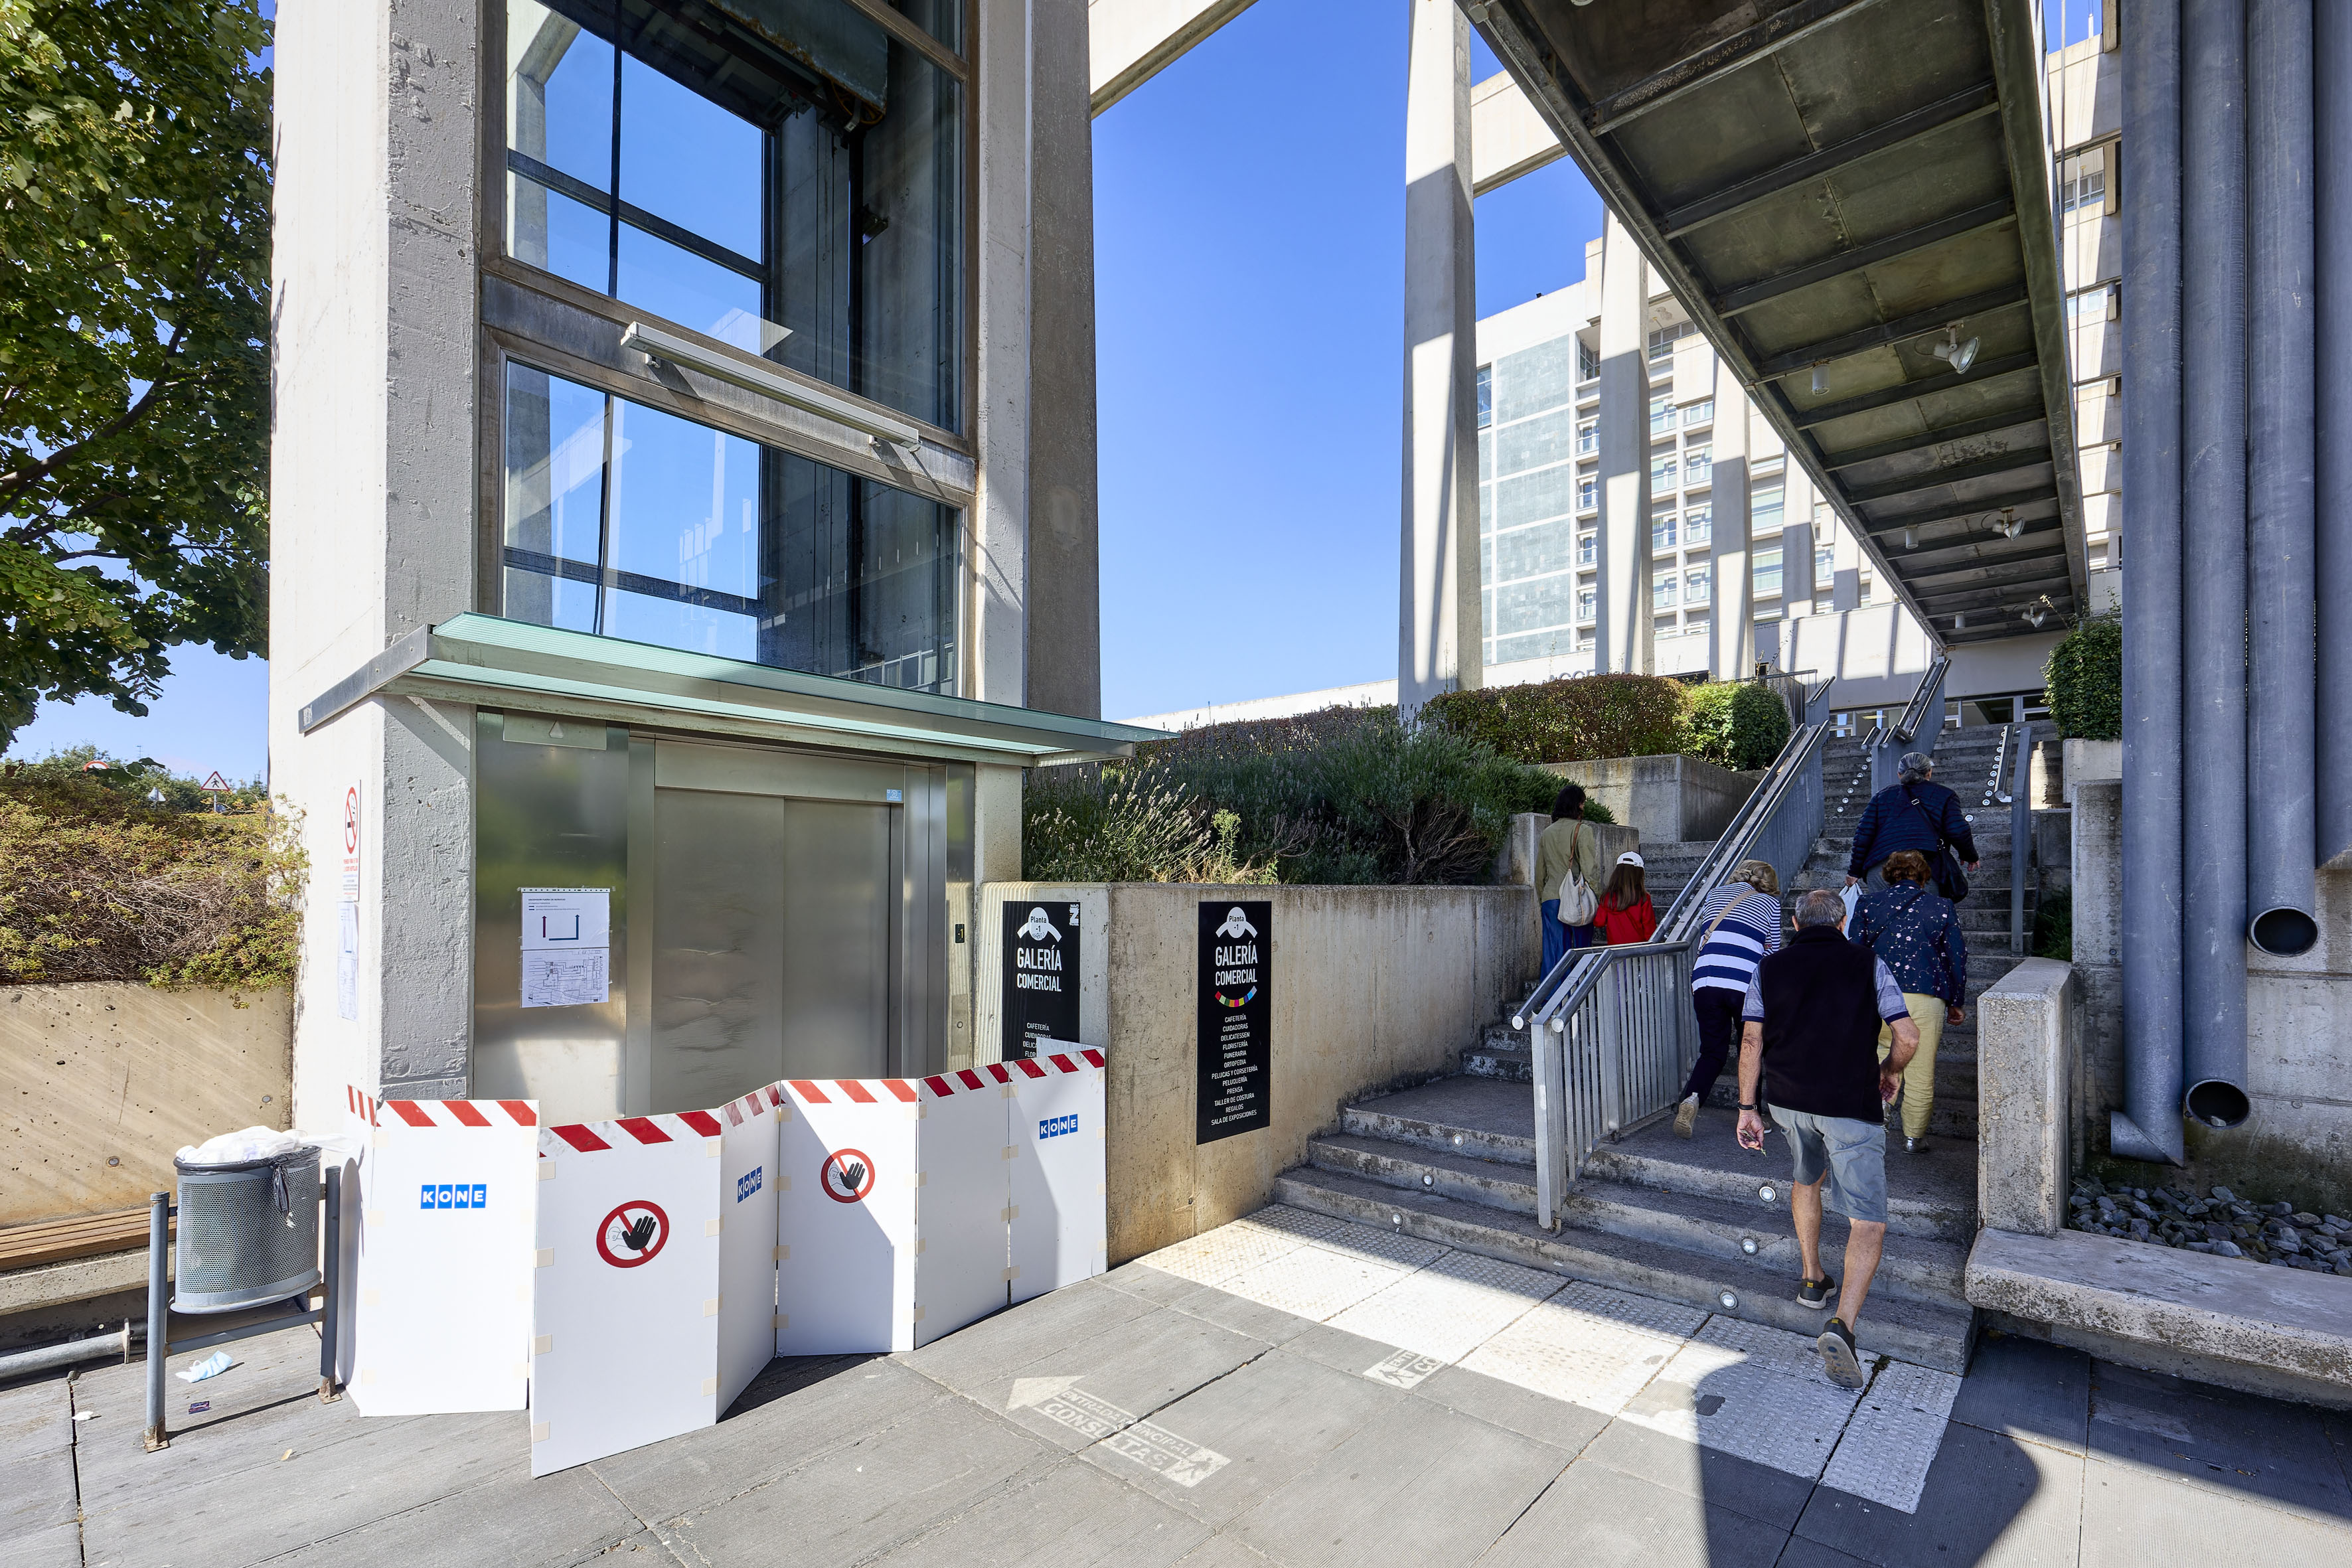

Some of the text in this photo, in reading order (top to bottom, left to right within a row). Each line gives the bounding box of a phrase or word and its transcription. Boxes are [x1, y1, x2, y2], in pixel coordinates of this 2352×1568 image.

[1017, 945, 1062, 971] GALERÍA
[1215, 940, 1258, 967] GALERÍA
[1017, 973, 1061, 992] COMERCIAL
[1215, 969, 1257, 986] COMERCIAL
[1225, 1014, 1247, 1022] CAFETERÍA
[1027, 1022, 1050, 1031] CAFETERÍA
[1223, 1023, 1248, 1032] CUIDADORAS
[1221, 1032, 1250, 1041] DELICATESSEN
[1223, 1040, 1248, 1050] FLORISTERÍA
[1224, 1050, 1247, 1059] FUNERARIA
[1224, 1059, 1247, 1068] ORTOPEDIA
[1212, 1070, 1230, 1079] PELUCAS
[1234, 1064, 1258, 1075] CORSETERÍA
[1222, 1075, 1247, 1086] PELUQUERÍA
[1227, 1086, 1243, 1095] PRENSA
[1214, 1097, 1230, 1107] TALLER
[1236, 1093, 1255, 1101] COSTURA
[1225, 1103, 1244, 1113] REGALOS
[1229, 1109, 1257, 1121] EXPOSICIONES
[1040, 1119, 1077, 1135] KONE
[738, 1172, 761, 1196] KONE
[422, 1190, 484, 1203] KONE
[1061, 1390, 1121, 1421] ENTRADA
